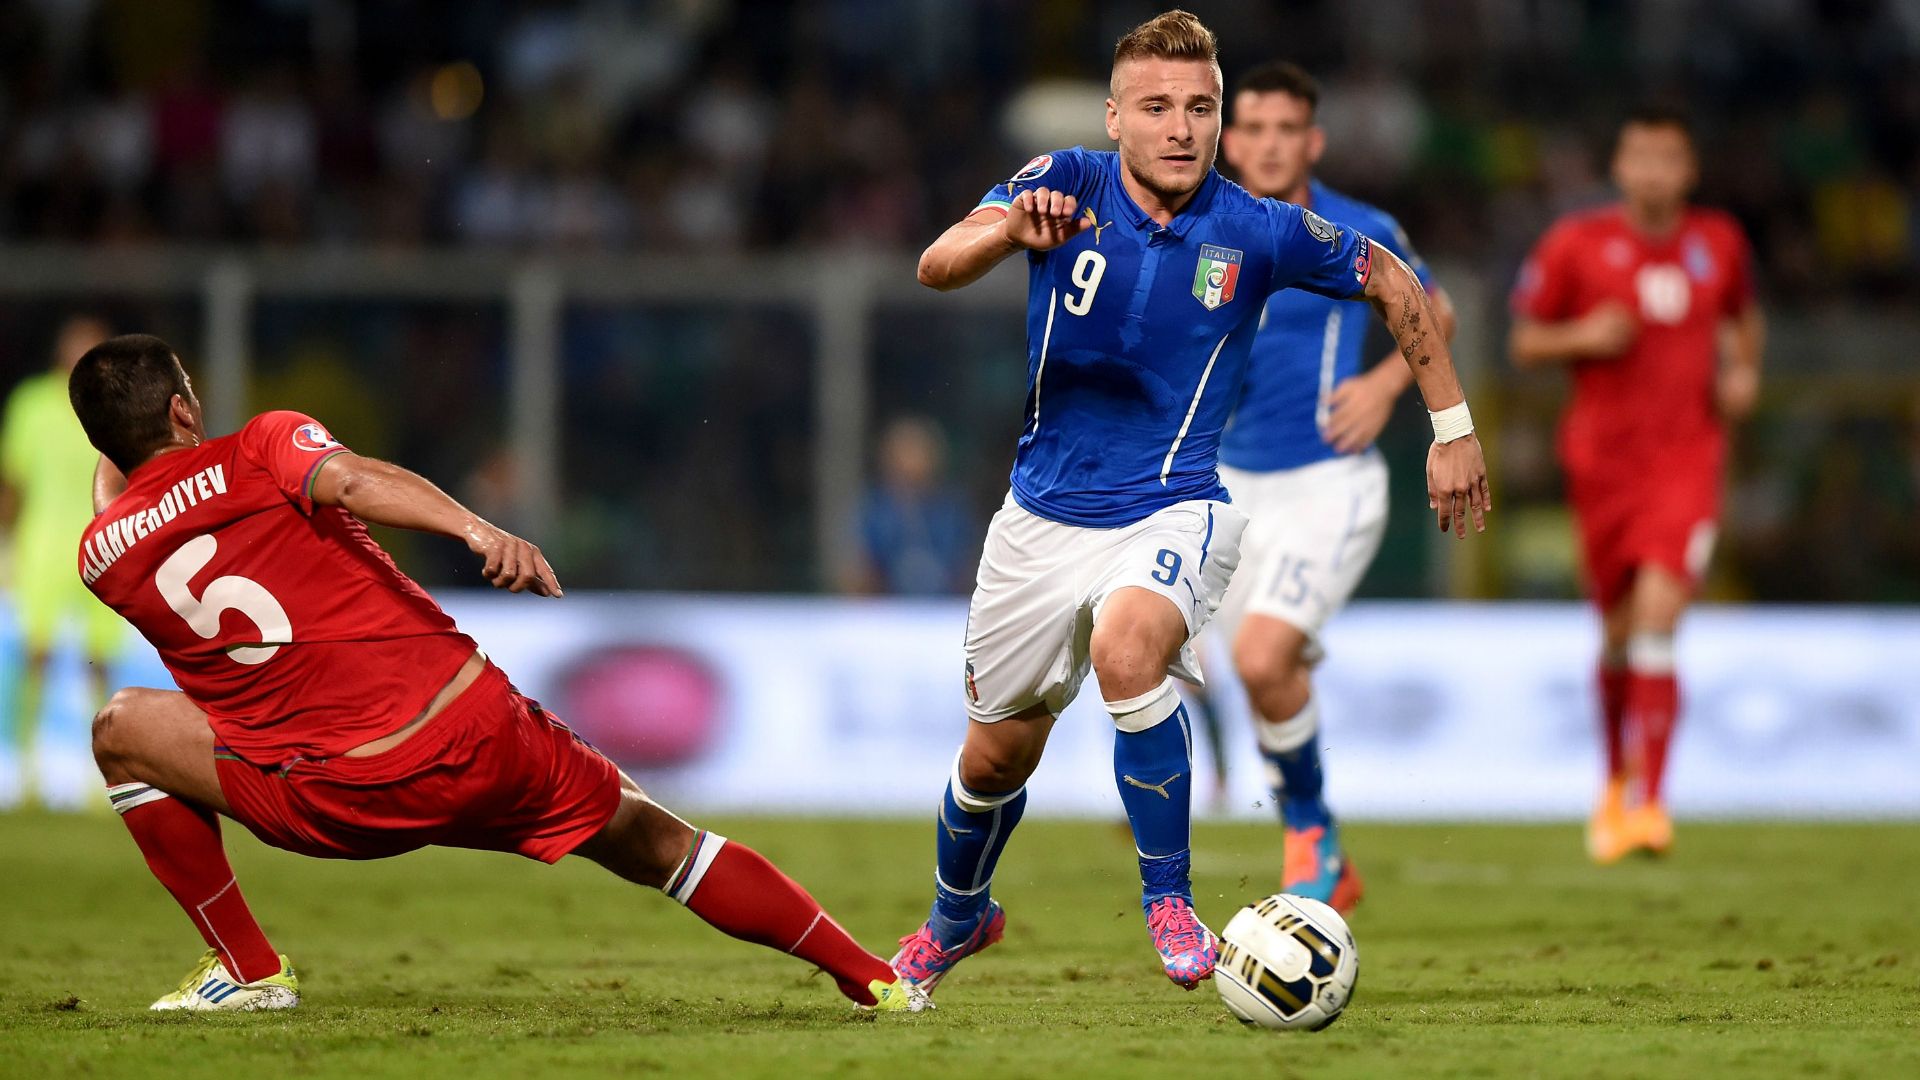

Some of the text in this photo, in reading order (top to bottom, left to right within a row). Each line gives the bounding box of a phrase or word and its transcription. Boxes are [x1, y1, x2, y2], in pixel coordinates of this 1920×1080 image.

[1205, 249, 1236, 261] ITALIA
[1063, 249, 1107, 316] 9
[1151, 548, 1183, 587] 9
[1266, 553, 1314, 607] 15
[155, 533, 293, 665] 5
